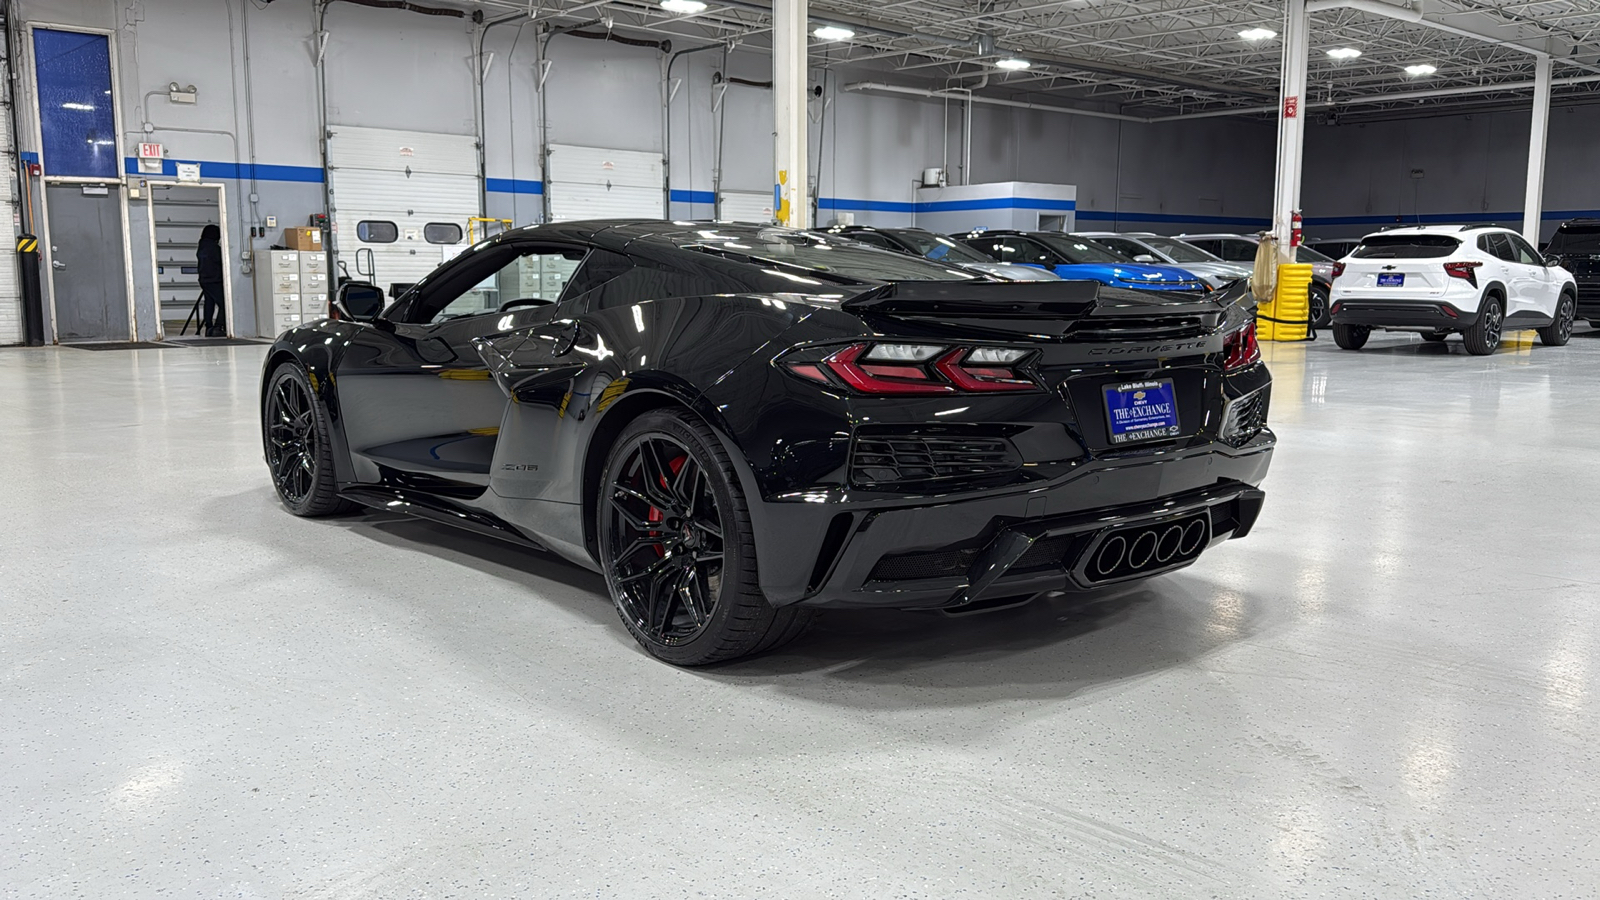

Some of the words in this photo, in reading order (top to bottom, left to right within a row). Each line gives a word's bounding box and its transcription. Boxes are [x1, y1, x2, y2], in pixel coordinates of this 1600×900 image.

[143, 143, 160, 157] EXIT
[1088, 341, 1206, 356] CORVETTE
[1114, 408, 1131, 420] THE
[1132, 403, 1171, 418] EXCHANGE
[1113, 433, 1128, 443] THE
[1132, 428, 1167, 440] EXCHANGE
